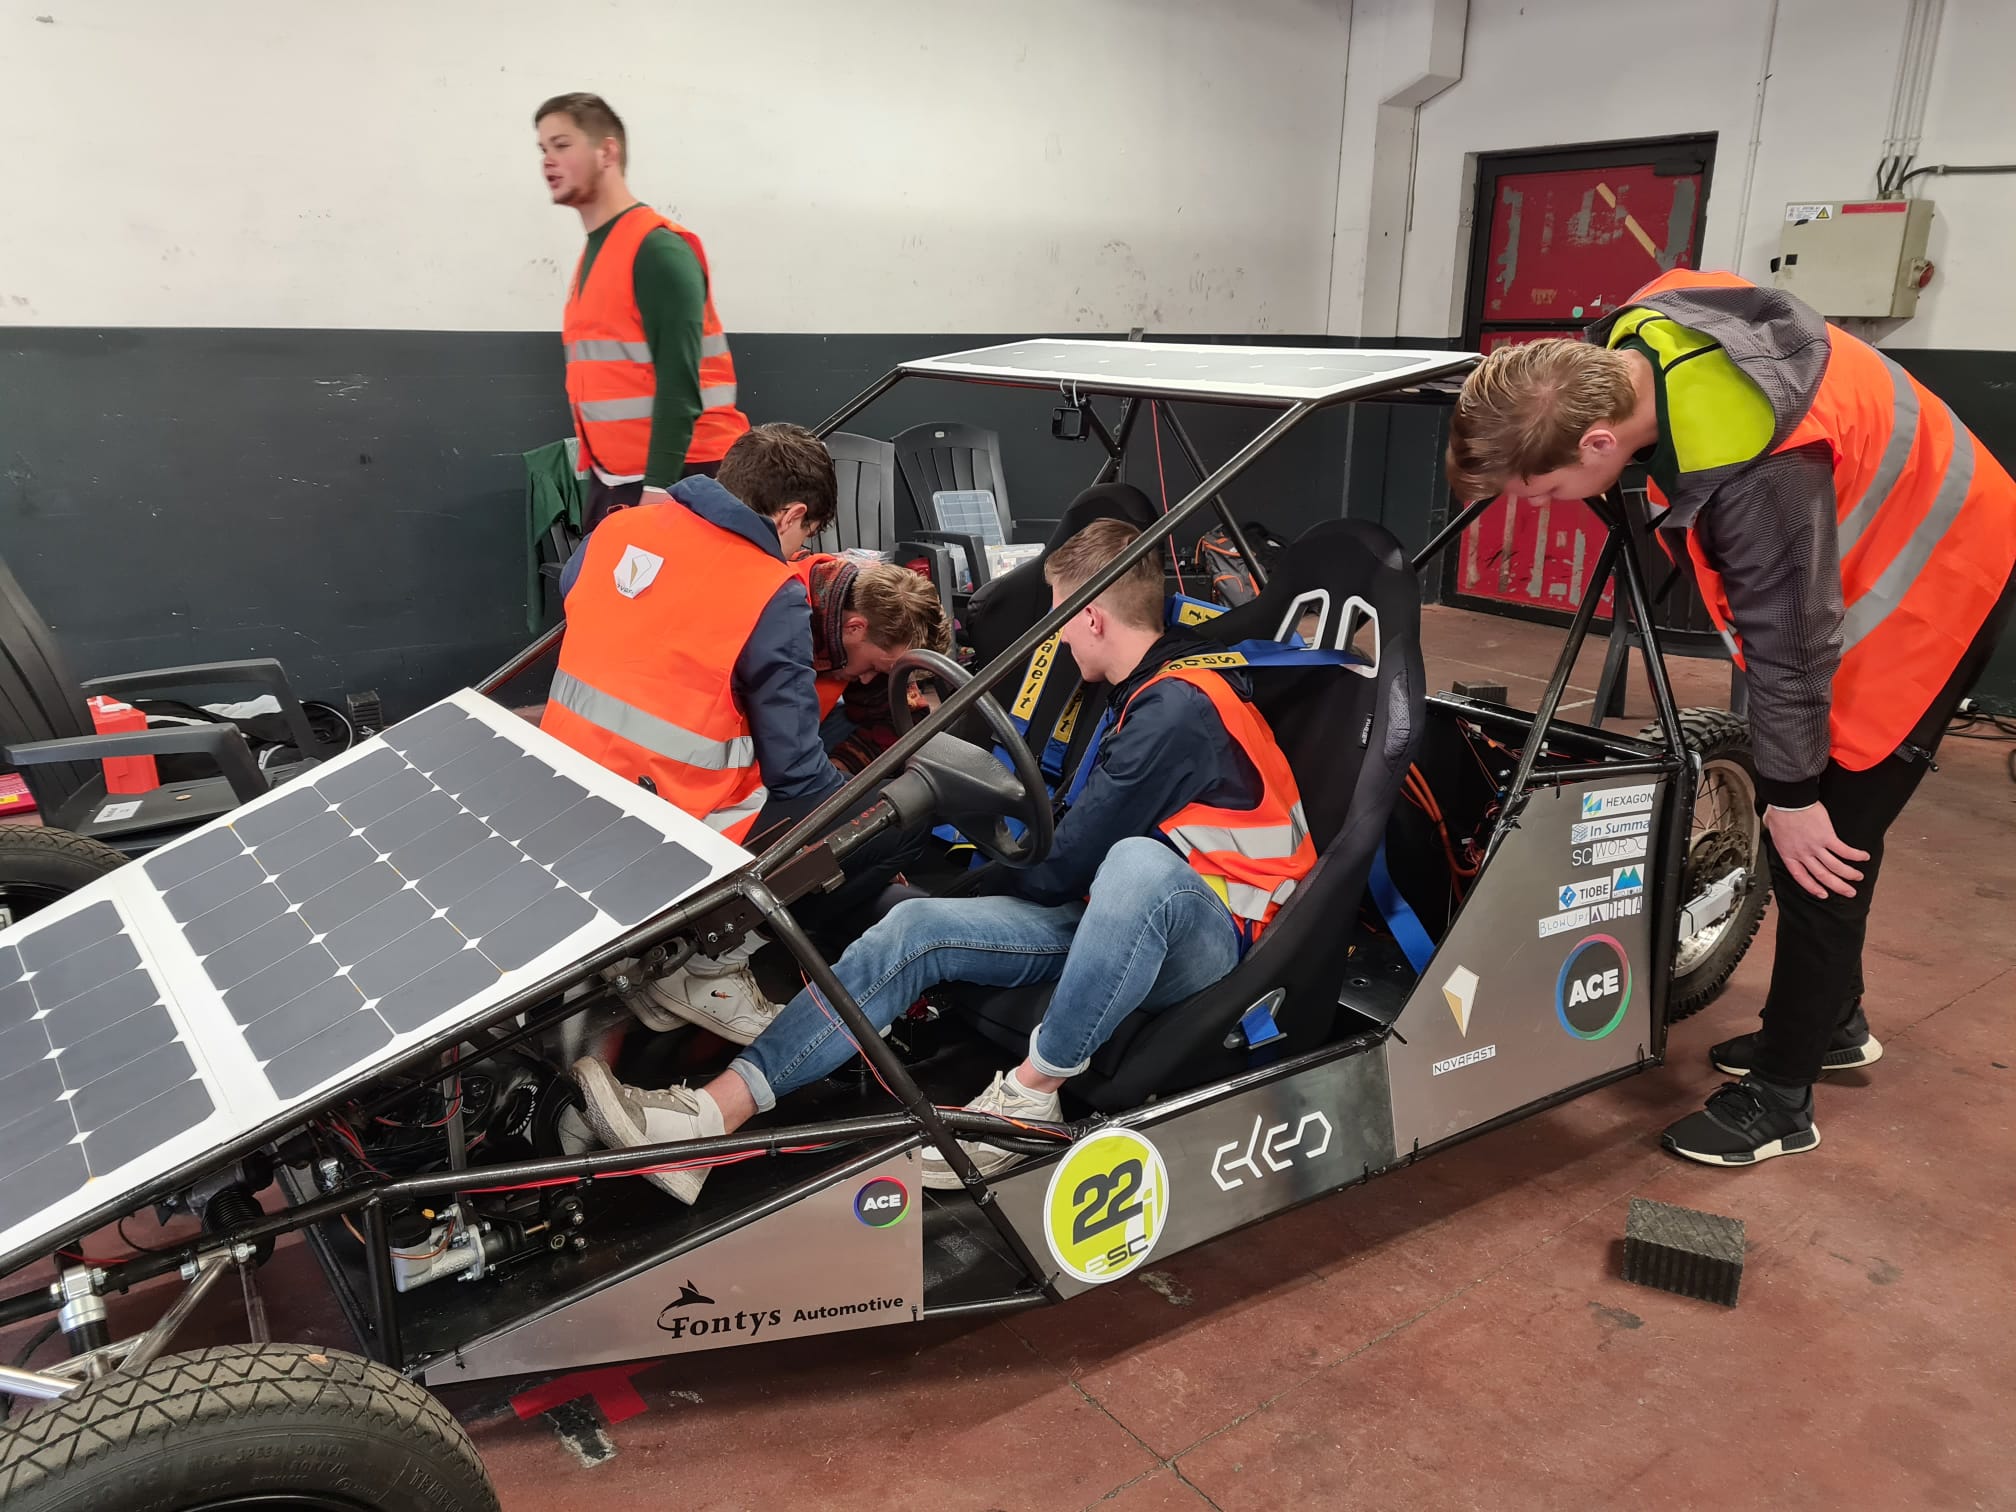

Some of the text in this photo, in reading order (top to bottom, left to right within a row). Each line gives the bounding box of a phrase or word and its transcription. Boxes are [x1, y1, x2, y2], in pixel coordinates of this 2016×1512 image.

[1606, 793, 1656, 808] HEXAGON
[1590, 820, 1651, 837] In Summa
[1580, 884, 1609, 899] TIOBE
[1568, 968, 1619, 1007] ACE
[1434, 1046, 1494, 1073] NOVAFAST
[863, 1194, 902, 1211] ACE
[1073, 1158, 1143, 1245] 22
[1085, 1234, 1148, 1274] ESC
[670, 1296, 904, 1339] Fontys Automotive
